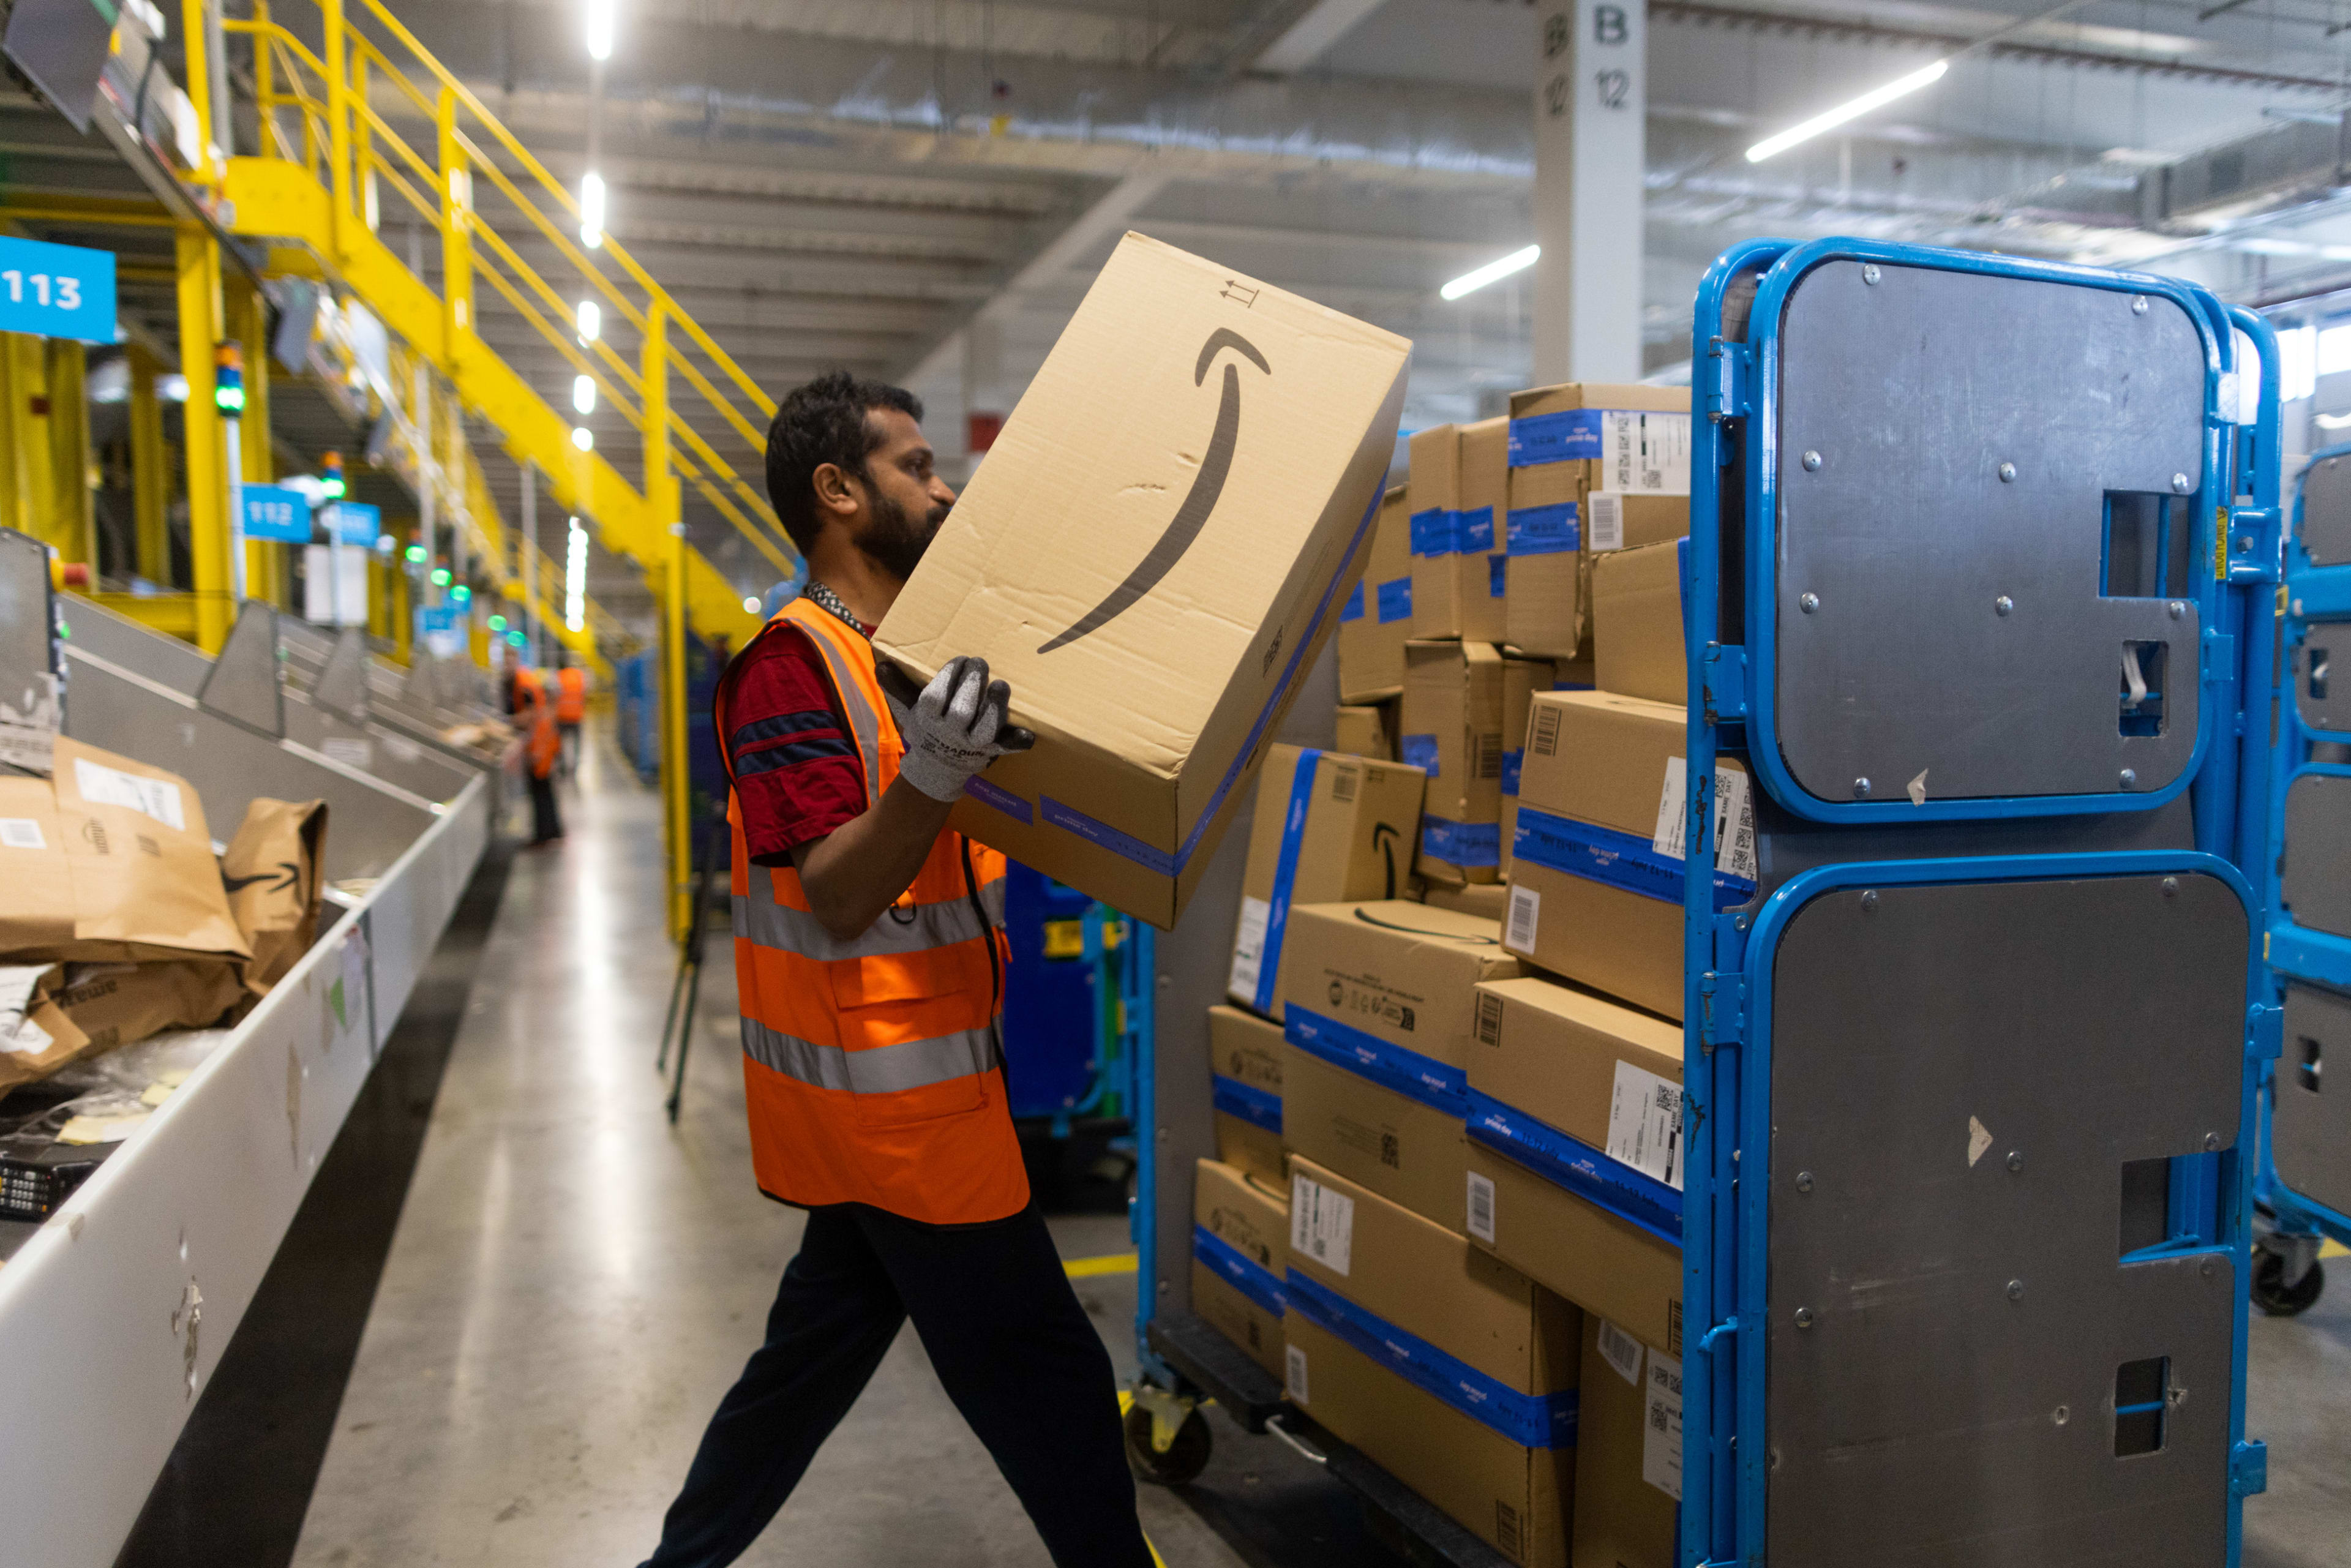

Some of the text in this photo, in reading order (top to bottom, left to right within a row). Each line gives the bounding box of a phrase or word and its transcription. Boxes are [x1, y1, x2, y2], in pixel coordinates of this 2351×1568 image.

[1593, 4, 1629, 45] B
[1595, 68, 1630, 110] 12
[2, 269, 81, 310] 113
